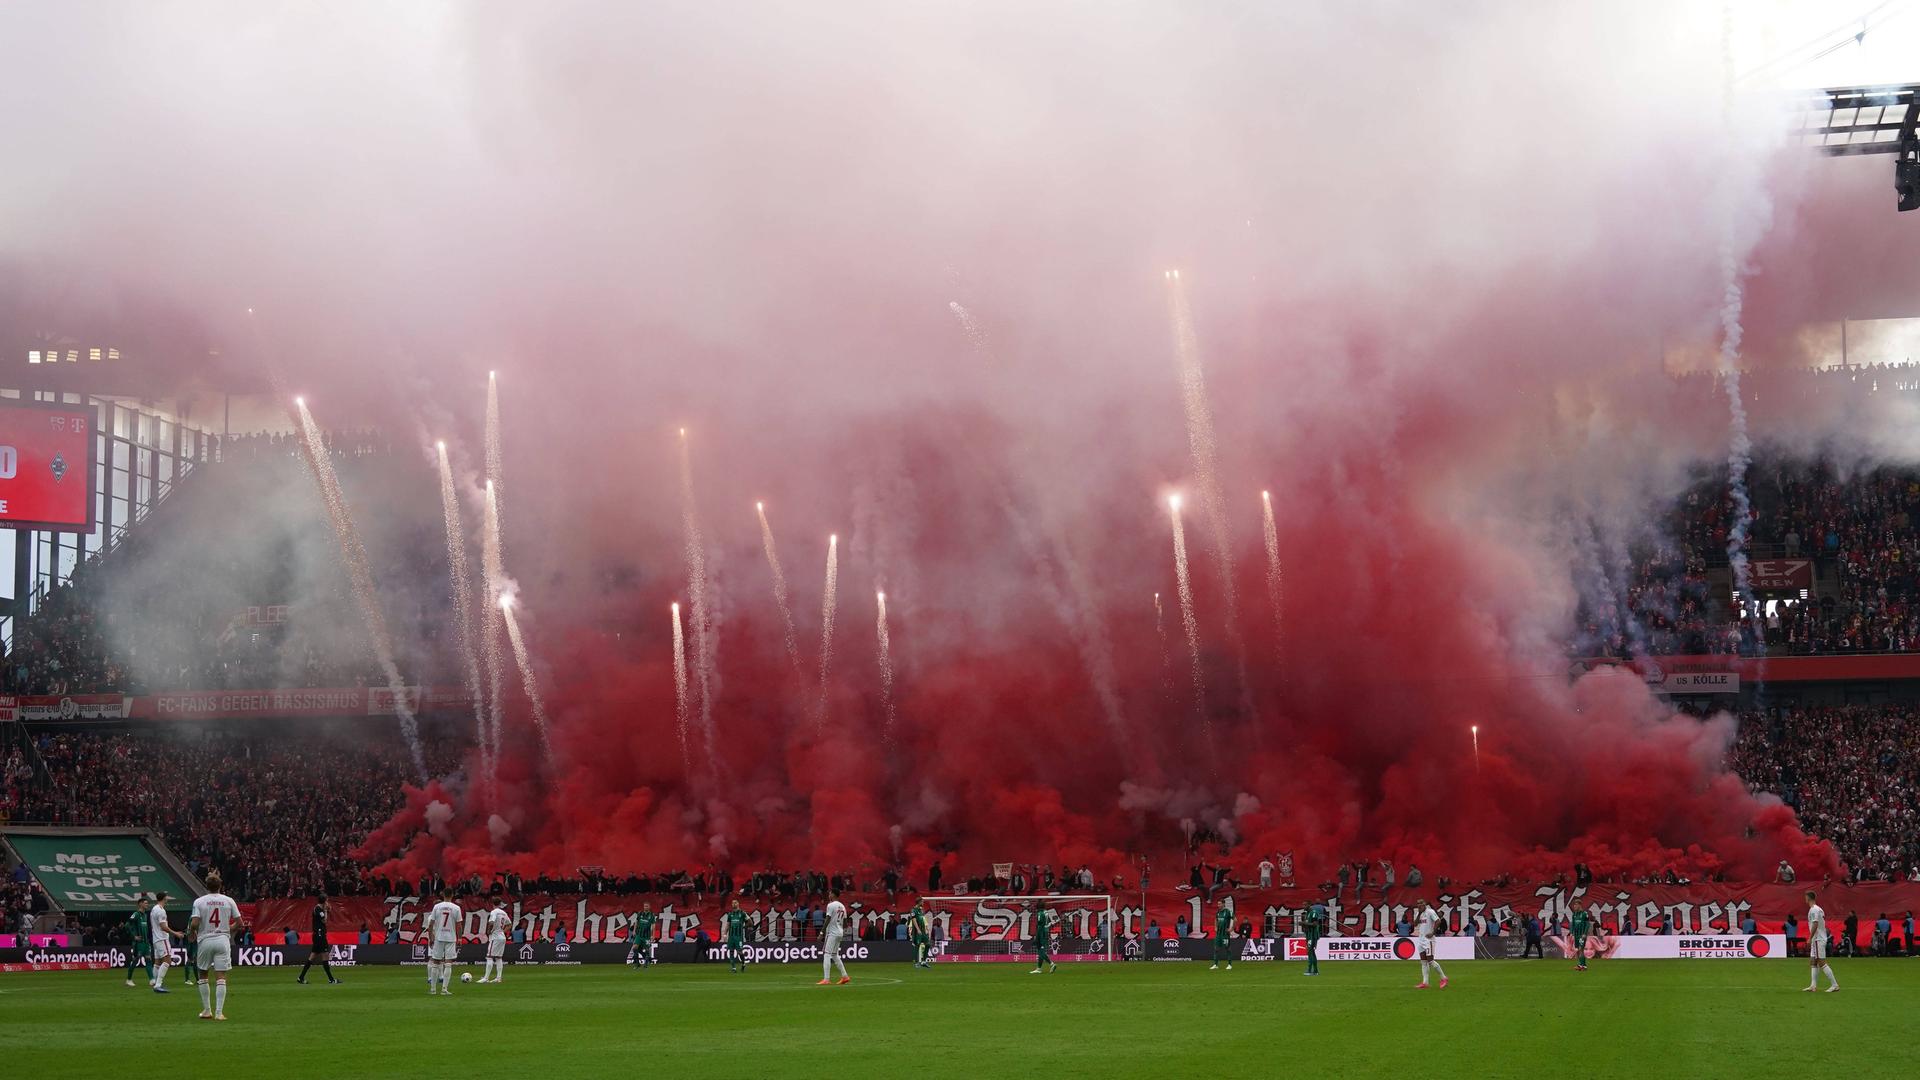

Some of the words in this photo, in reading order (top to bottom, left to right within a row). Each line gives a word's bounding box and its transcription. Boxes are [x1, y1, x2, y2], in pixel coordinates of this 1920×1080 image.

[1693, 674, 1728, 685] KÖLLE
[157, 697, 217, 713] FC-FANS
[221, 695, 269, 711] GEGEN
[273, 692, 360, 709] RASSISMUS
[55, 853, 122, 865] Mer
[38, 865, 119, 875] stonn
[125, 865, 156, 873] zo
[76, 876, 140, 888] Dir!
[208, 908, 221, 928] 4
[442, 911, 450, 928] 7
[571, 898, 704, 943] hete
[1264, 890, 1513, 939] rt-wiße
[1535, 886, 1752, 937] Krieger
[1328, 939, 1392, 951] BRÖTJE
[1679, 937, 1745, 949] BRÖTJE
[25, 948, 126, 967] Schanzenstraße
[238, 946, 284, 966] Köln
[1328, 952, 1392, 960] HEIZUNG
[1679, 950, 1745, 958] HEIZUNG
